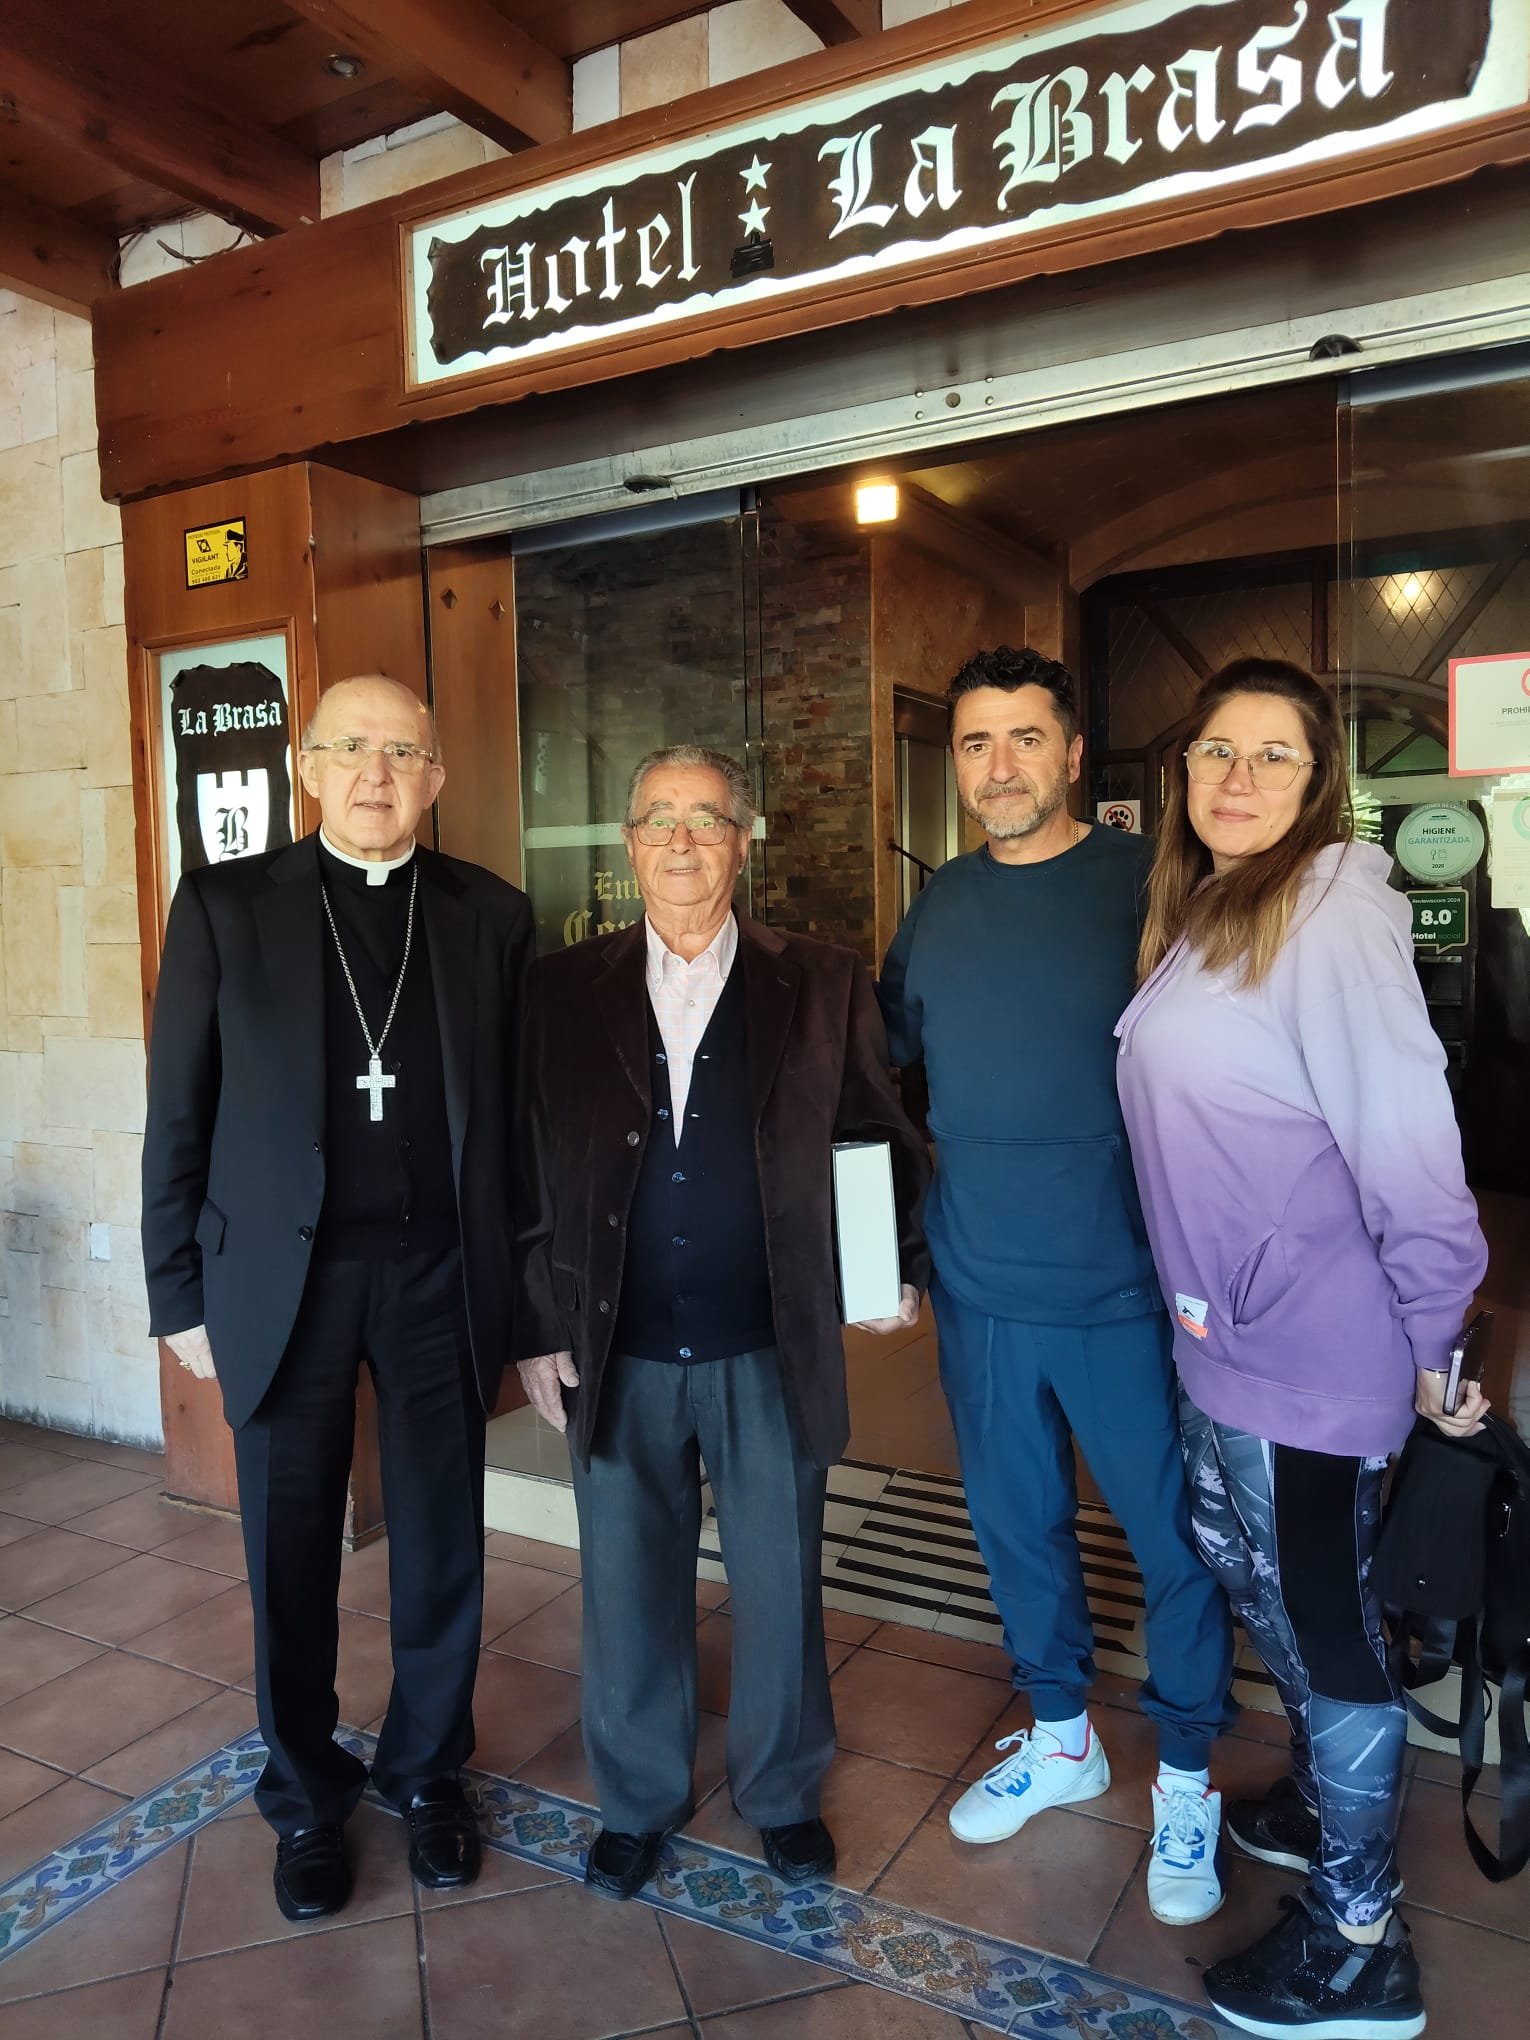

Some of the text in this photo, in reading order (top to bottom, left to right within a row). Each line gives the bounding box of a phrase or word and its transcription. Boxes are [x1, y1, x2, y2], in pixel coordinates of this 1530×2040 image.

[480, 0, 1395, 330] Hotel La Brasa
[178, 700, 283, 737] La Brasa
[215, 806, 249, 862] B
[1422, 827, 1456, 835] HIGIENE
[1408, 836, 1471, 845] GARANTIZADA
[1420, 909, 1452, 926] 8.0
[1412, 932, 1437, 940] Hotel
